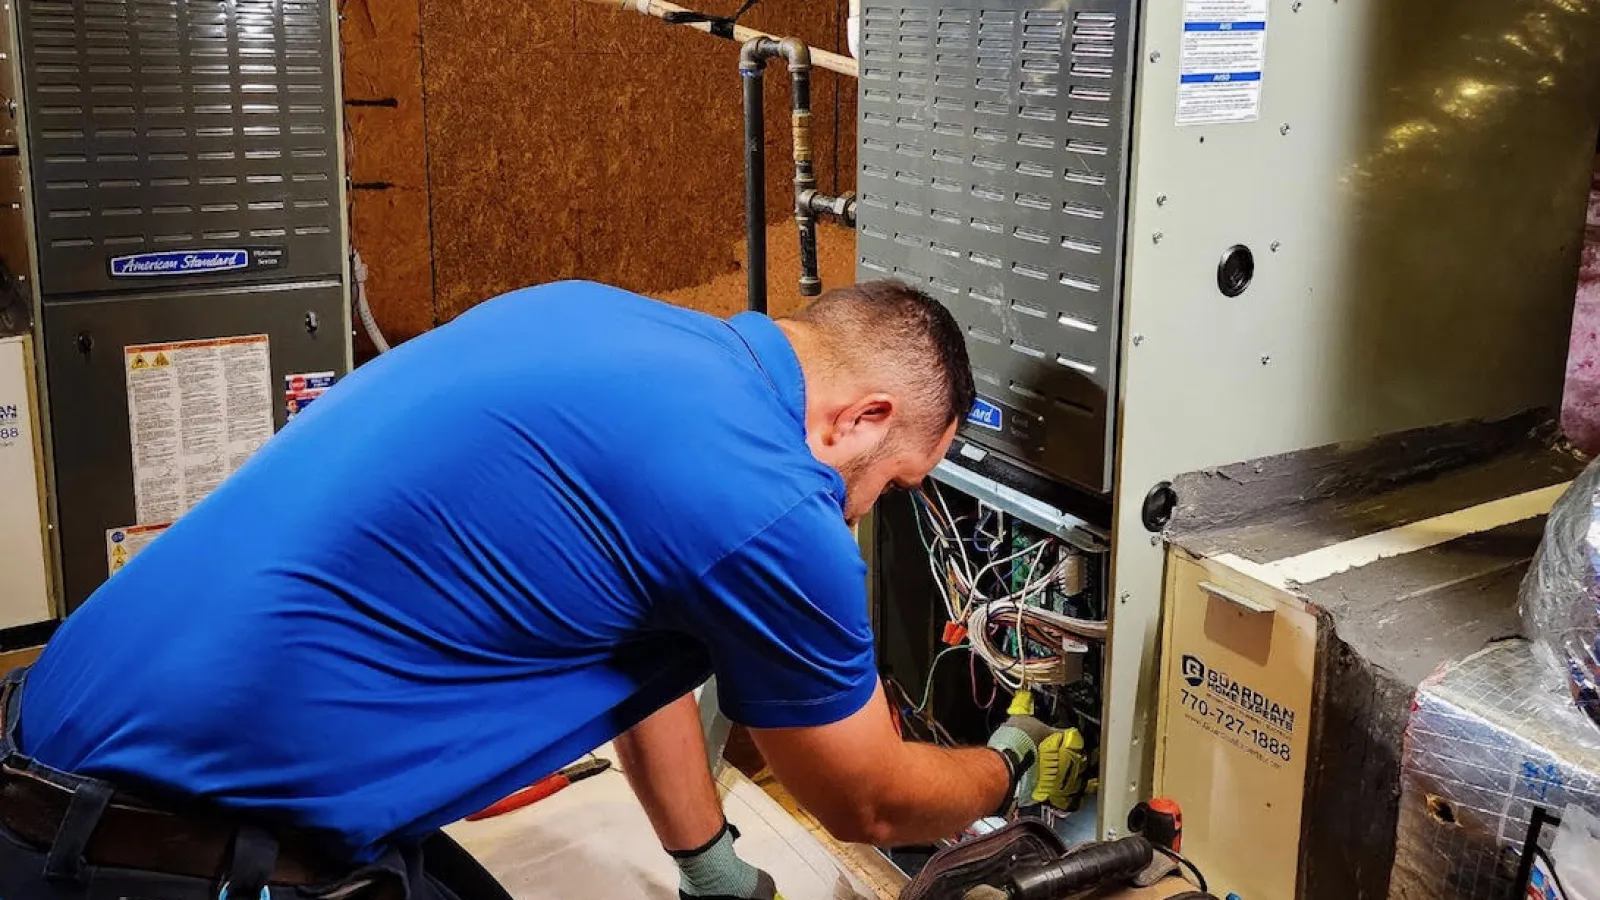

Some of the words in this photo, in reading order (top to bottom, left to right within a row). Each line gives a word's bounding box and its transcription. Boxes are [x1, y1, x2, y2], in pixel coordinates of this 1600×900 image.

[121, 258, 178, 273] American
[180, 252, 237, 269] Standard
[1208, 669, 1295, 723] GUARDIAN
[1180, 688, 1290, 762] 770-727-1888
